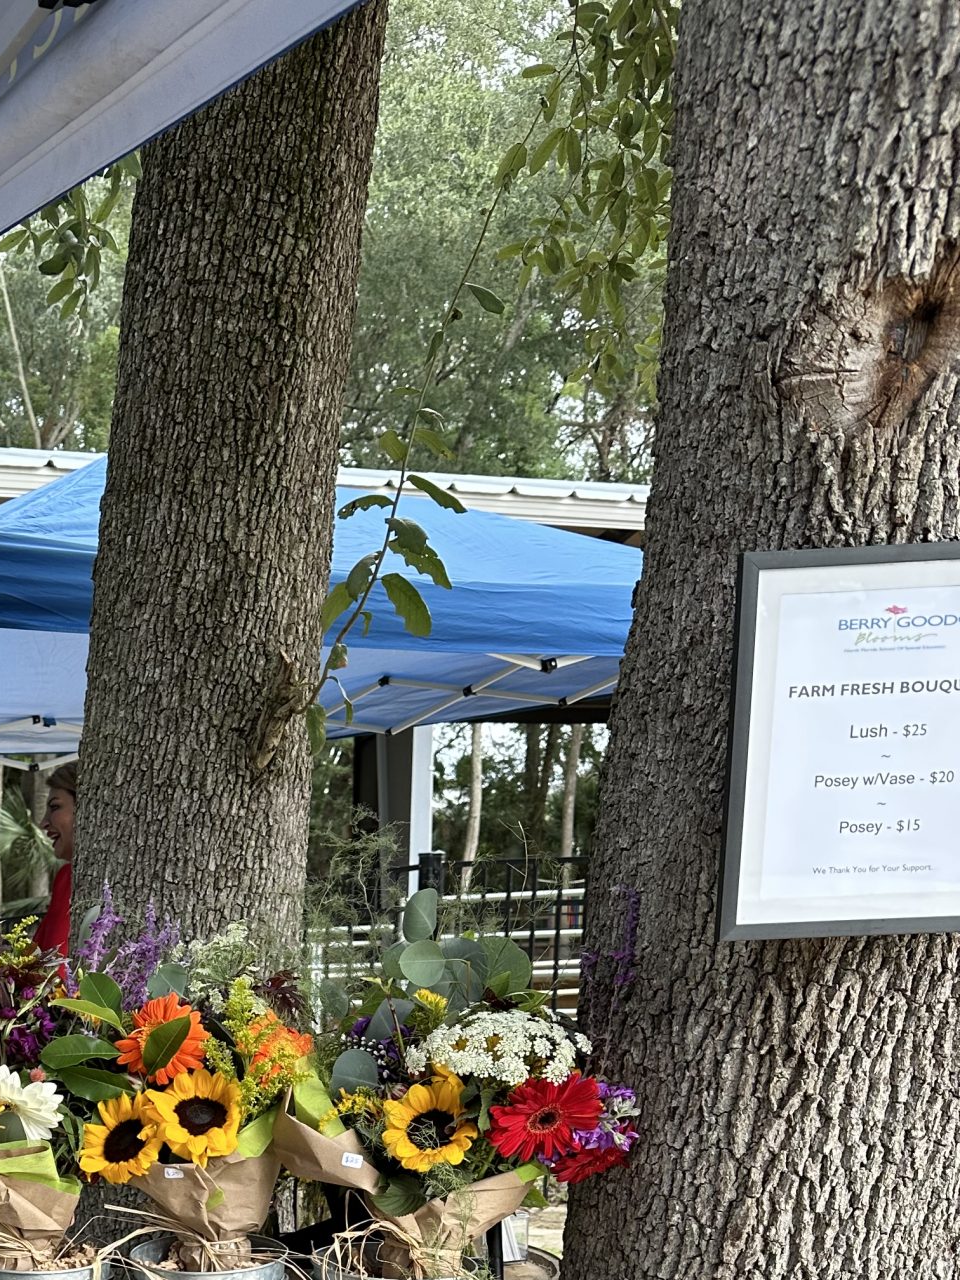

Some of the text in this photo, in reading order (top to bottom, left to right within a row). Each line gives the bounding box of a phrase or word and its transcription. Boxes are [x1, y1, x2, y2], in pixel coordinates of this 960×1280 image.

[838, 614, 958, 631] BERRY GOOD
[788, 684, 836, 699] FARM
[840, 681, 895, 696] FRESH
[849, 723, 888, 739] Lush
[902, 723, 928, 738] $25
[814, 775, 859, 790] Posey
[862, 772, 916, 786] w/Vase
[929, 770, 955, 785] $20
[839, 821, 883, 836] Posey
[896, 818, 921, 833] $15
[812, 867, 827, 875] We
[828, 866, 851, 874] Thank
[852, 865, 867, 873] You
[868, 864, 880, 873] for
[881, 864, 900, 872] Your
